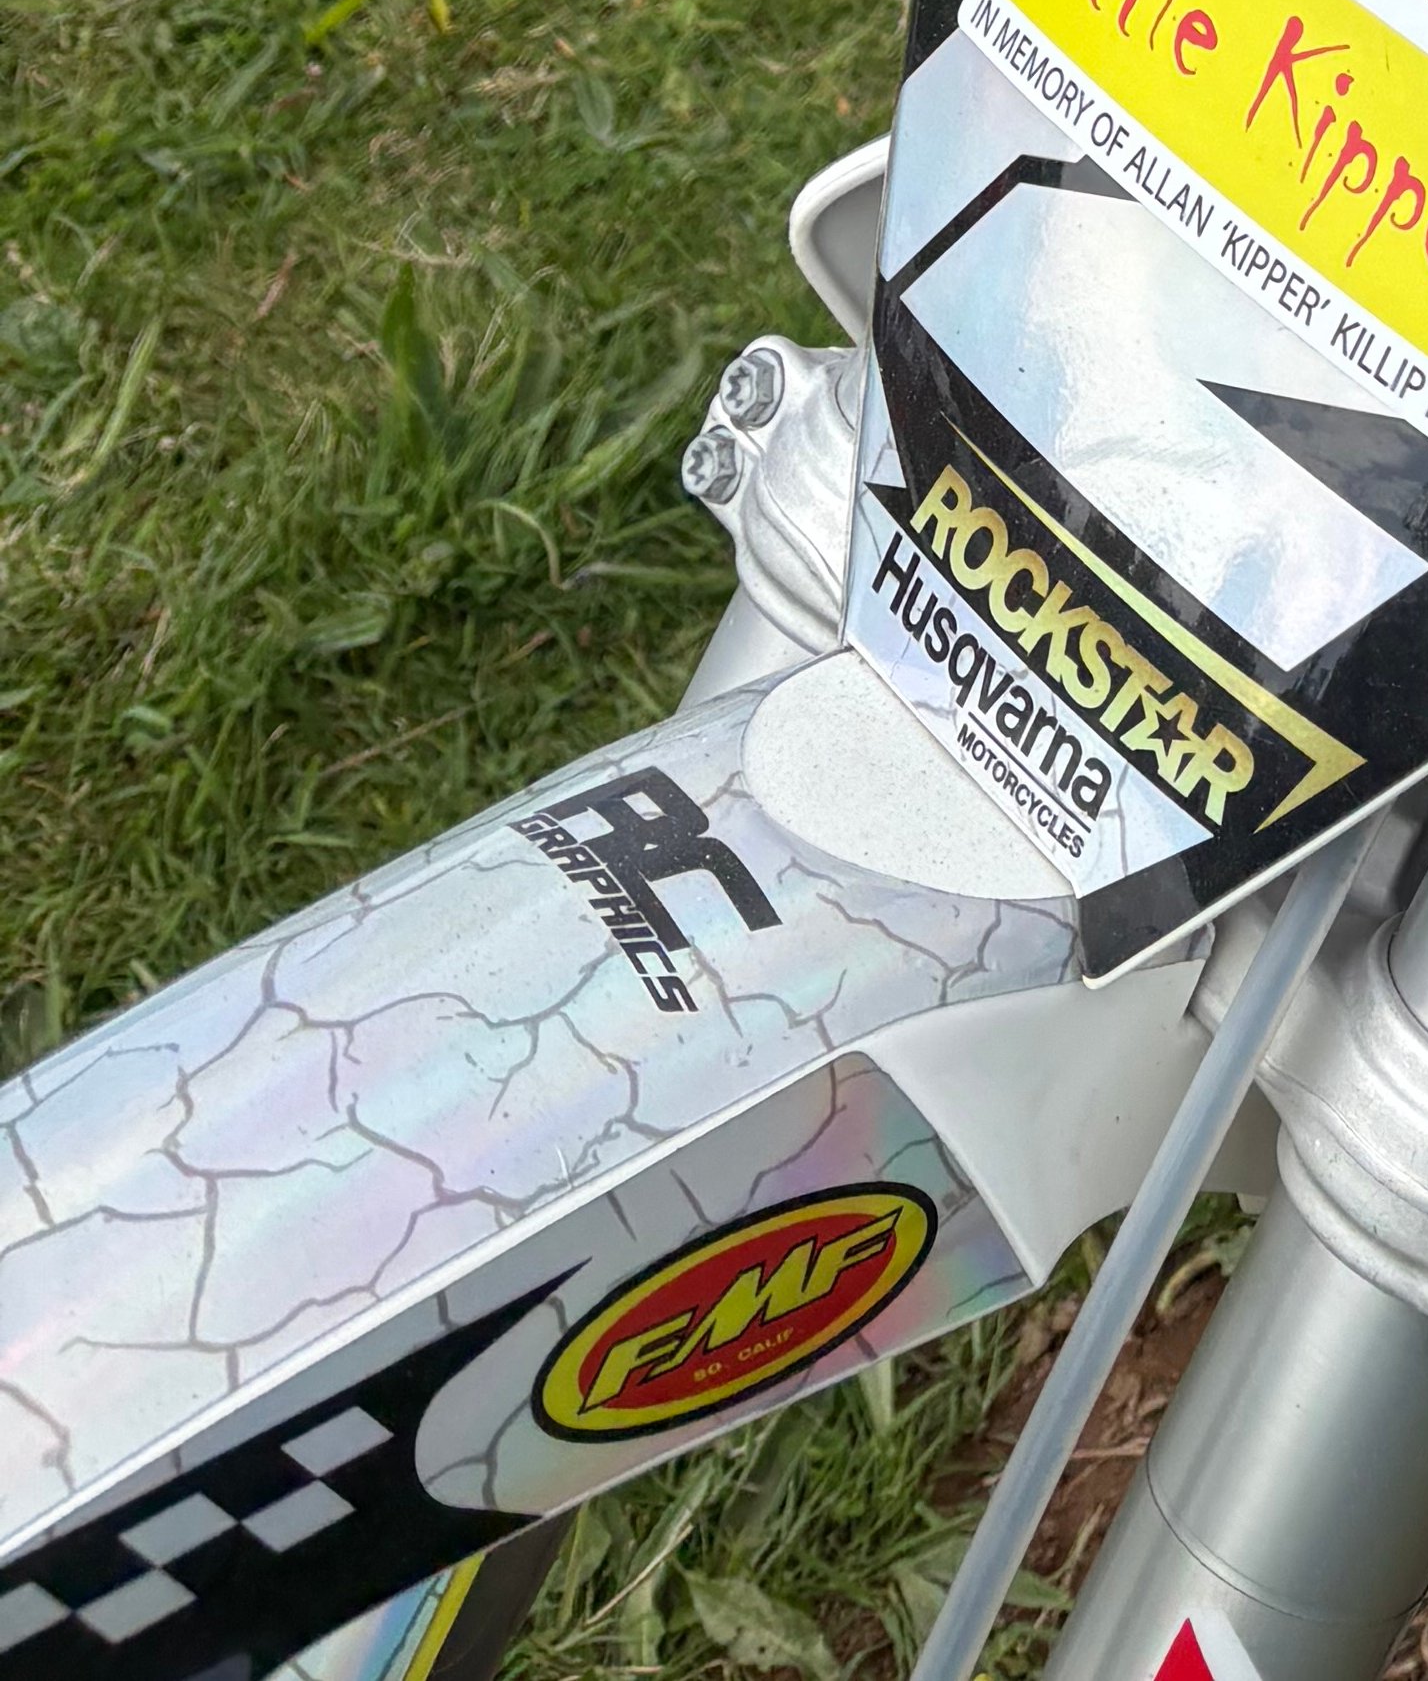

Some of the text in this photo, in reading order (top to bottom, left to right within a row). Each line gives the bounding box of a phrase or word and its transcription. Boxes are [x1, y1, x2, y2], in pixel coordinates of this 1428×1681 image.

[994, 13, 1093, 129] MEMORY
[1089, 104, 1131, 162] OF
[1122, 137, 1214, 239] ALLAN
[1330, 320, 1428, 401] KILLIP
[871, 531, 1113, 821] Husqvarna
[909, 463, 1256, 826] ROCKSTAR
[955, 722, 1086, 860] MOTORCYCLES
[505, 811, 700, 1013] GRAPHICS
[576, 1205, 904, 1416] FMF
[736, 1326, 795, 1363] CALIF
